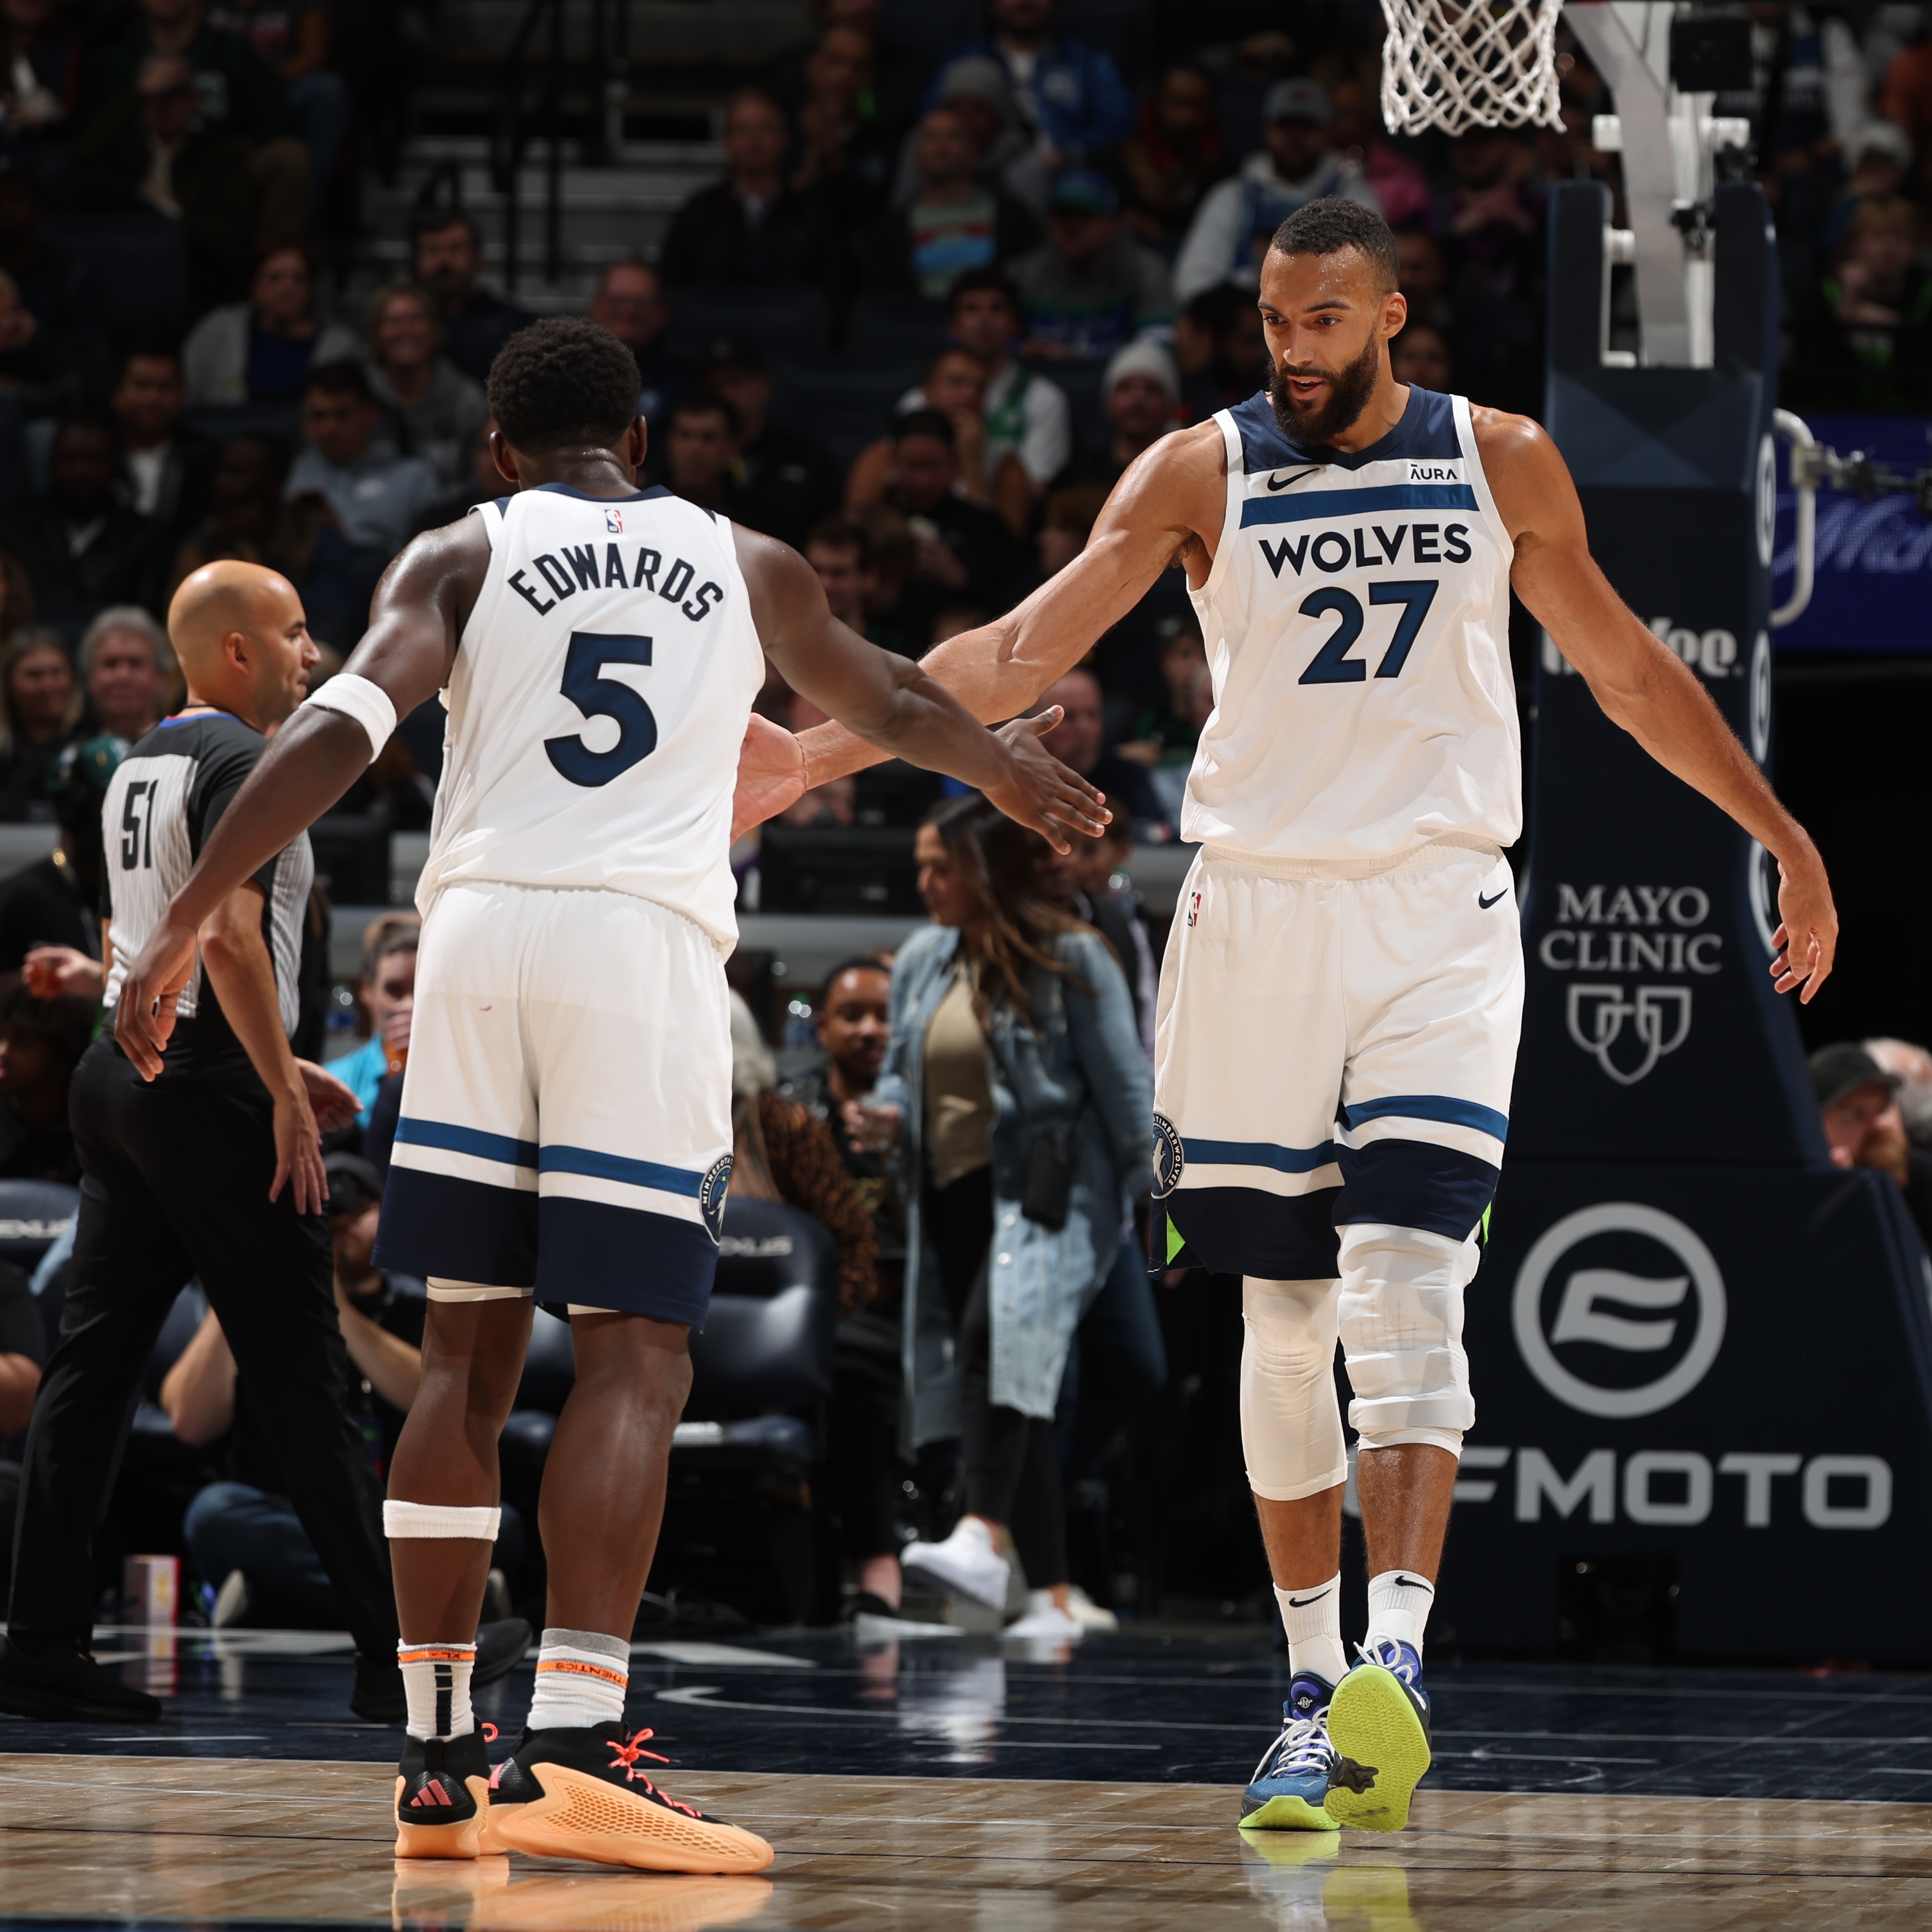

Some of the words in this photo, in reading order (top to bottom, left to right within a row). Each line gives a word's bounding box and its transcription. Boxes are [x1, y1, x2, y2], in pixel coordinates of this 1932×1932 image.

[507, 543, 724, 622] EDWARDS
[1258, 523, 1472, 579] WOLVES
[1298, 579, 1439, 685] 27
[543, 631, 658, 788] 5
[122, 779, 159, 871] 51
[1556, 883, 1711, 928] MAYO
[1538, 928, 1724, 974] CLINIC
[702, 1157, 731, 1204] MINNESOTA
[1155, 1116, 1181, 1186] TIMBERWOLVES
[555, 1662, 628, 1686] UTHENTICS
